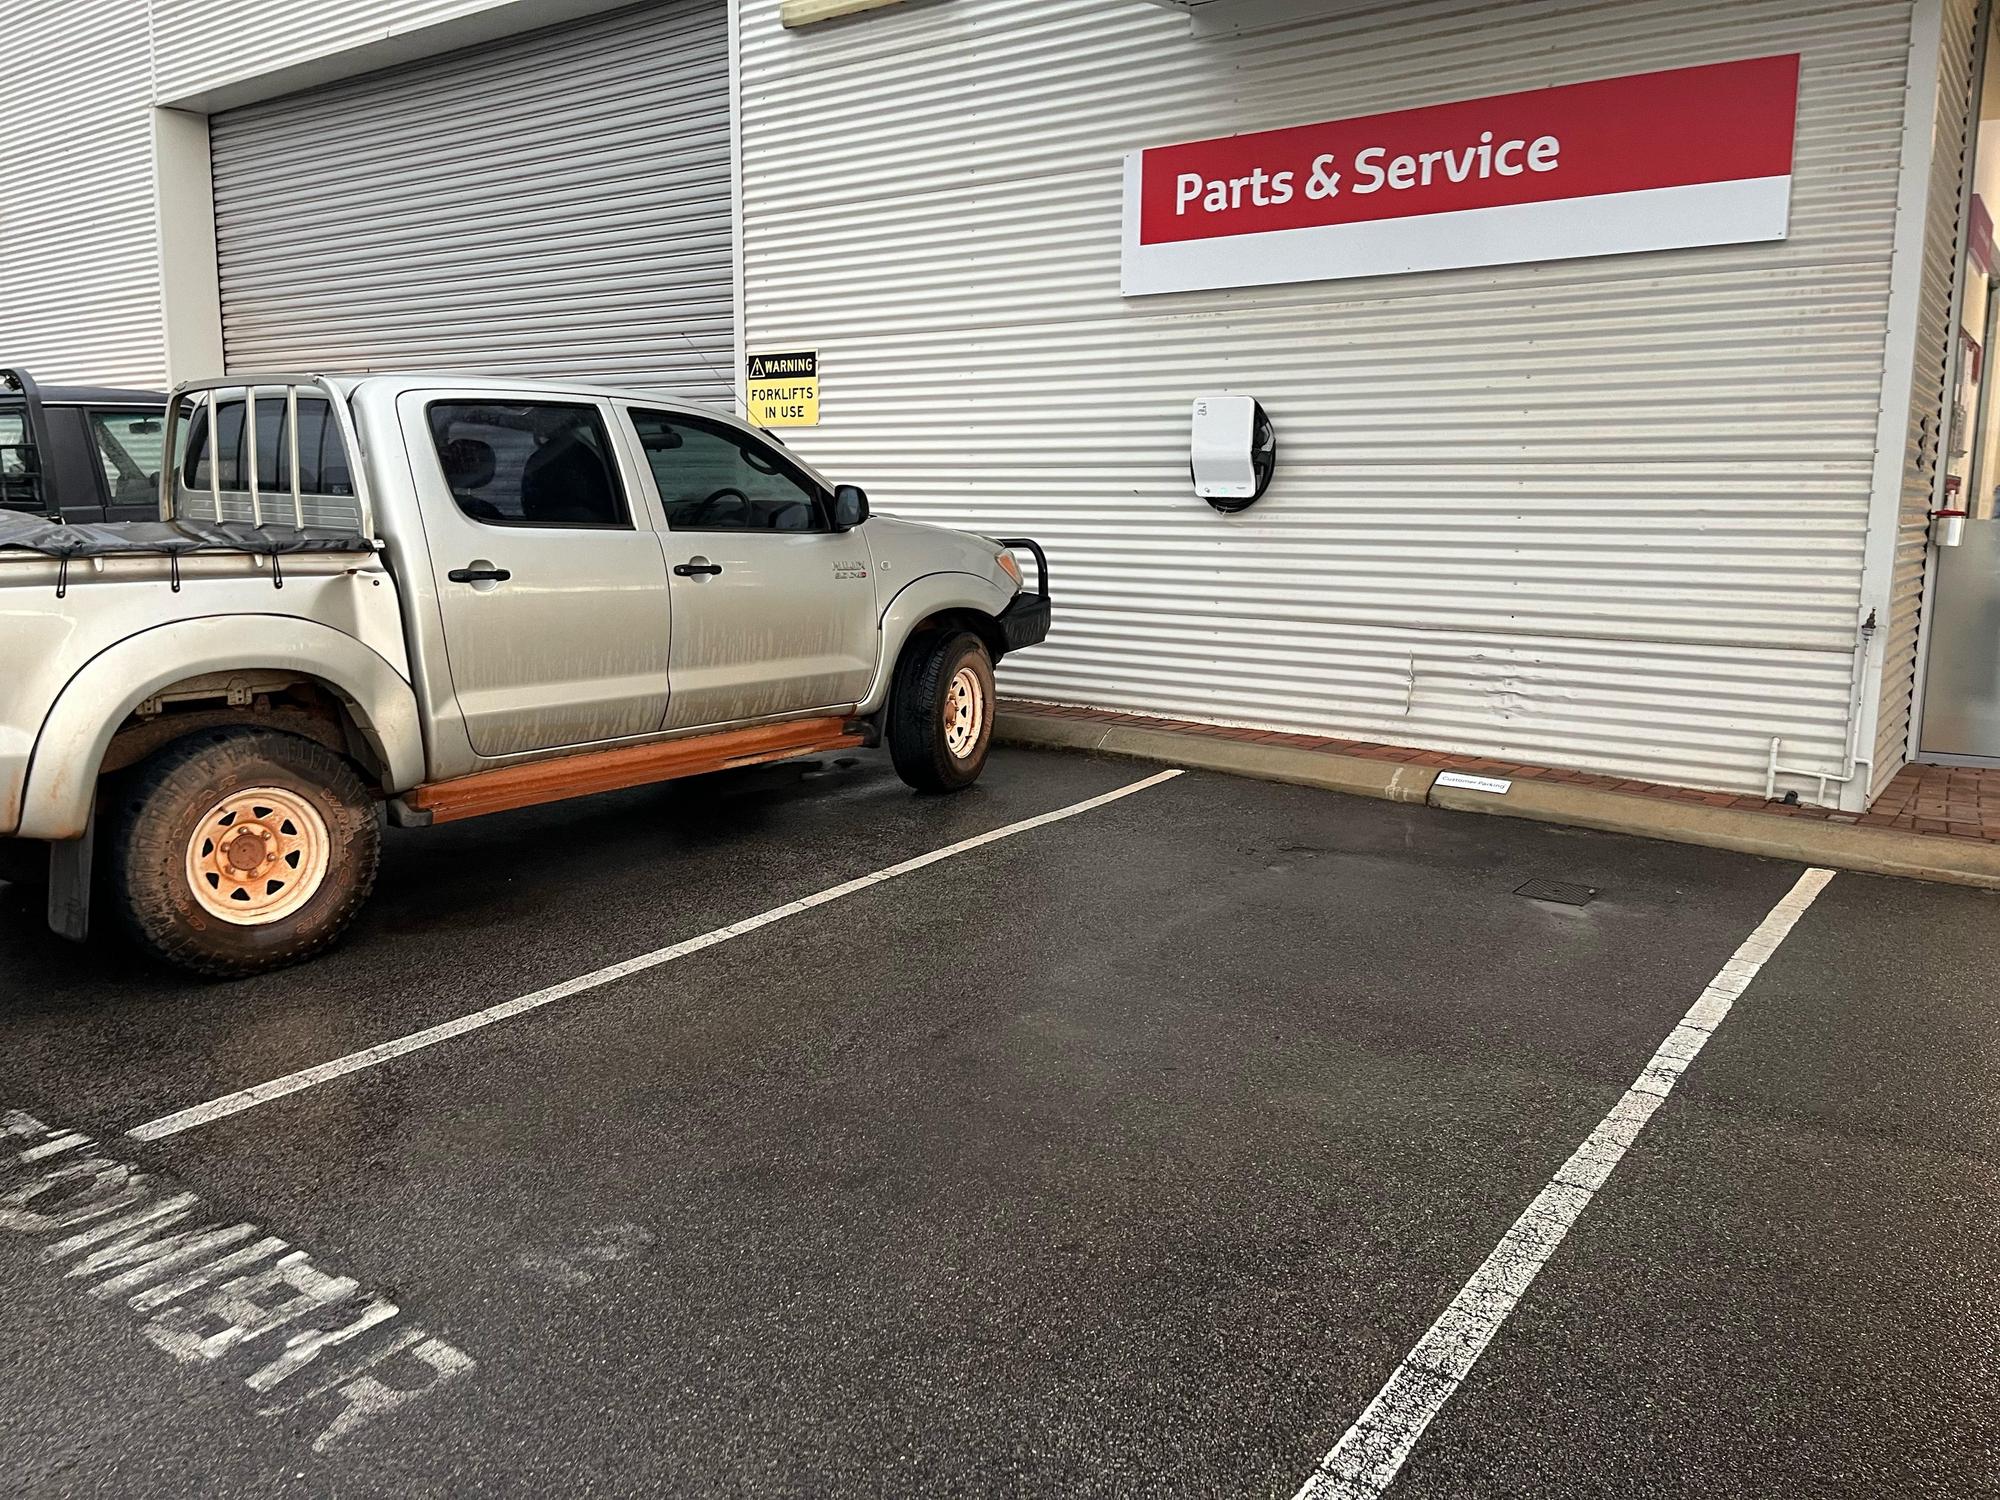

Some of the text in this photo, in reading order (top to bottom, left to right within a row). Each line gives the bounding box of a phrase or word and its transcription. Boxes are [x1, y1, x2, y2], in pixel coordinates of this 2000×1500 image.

[1175, 131, 1561, 216] Parts & Service
[764, 358, 813, 374] WARNING
[751, 386, 814, 401] FORKLIFTS
[765, 406, 804, 418] IN USE
[1442, 775, 1506, 790] Customer Parking
